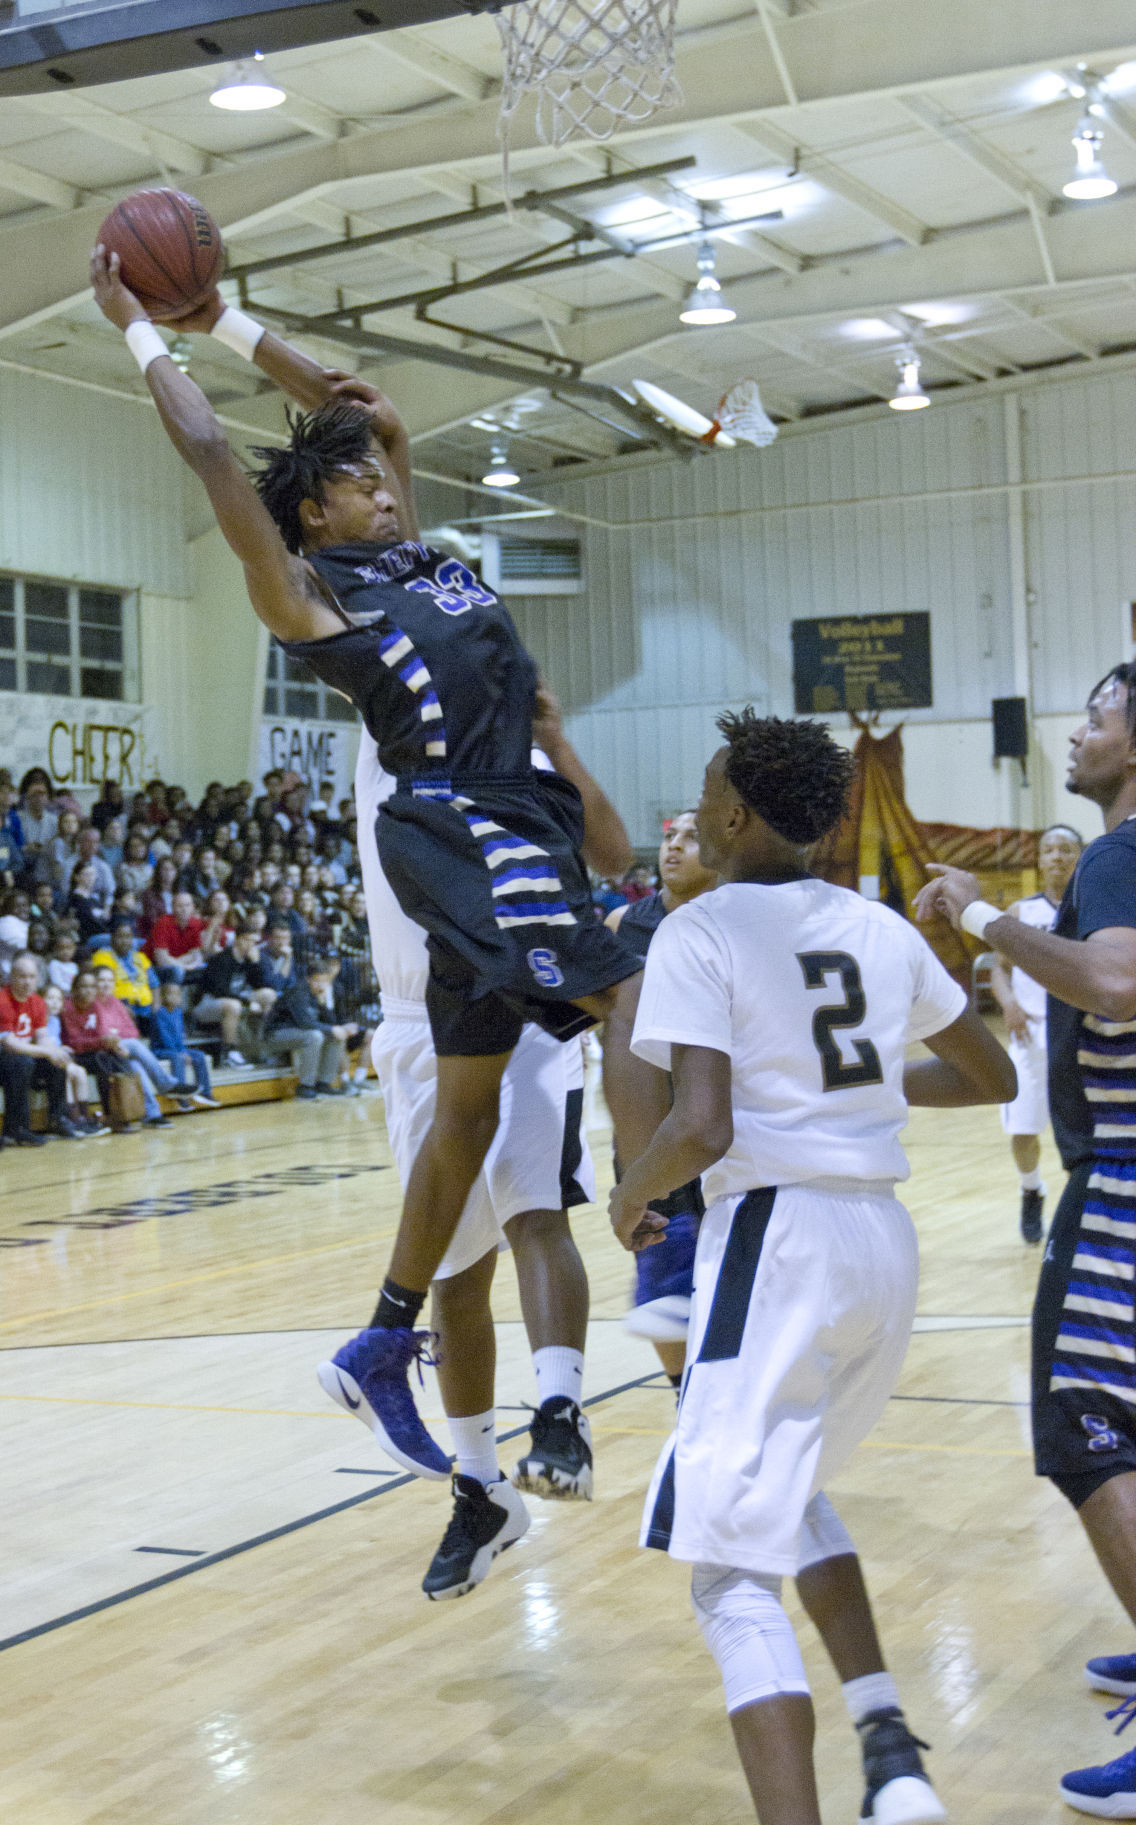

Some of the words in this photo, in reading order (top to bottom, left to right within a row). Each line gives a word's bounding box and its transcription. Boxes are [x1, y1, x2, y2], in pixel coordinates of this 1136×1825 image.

[404, 557, 498, 616] 33
[48, 720, 136, 786] CHEER
[269, 726, 336, 776] GAME
[526, 948, 565, 988] S
[795, 950, 883, 1092] 2
